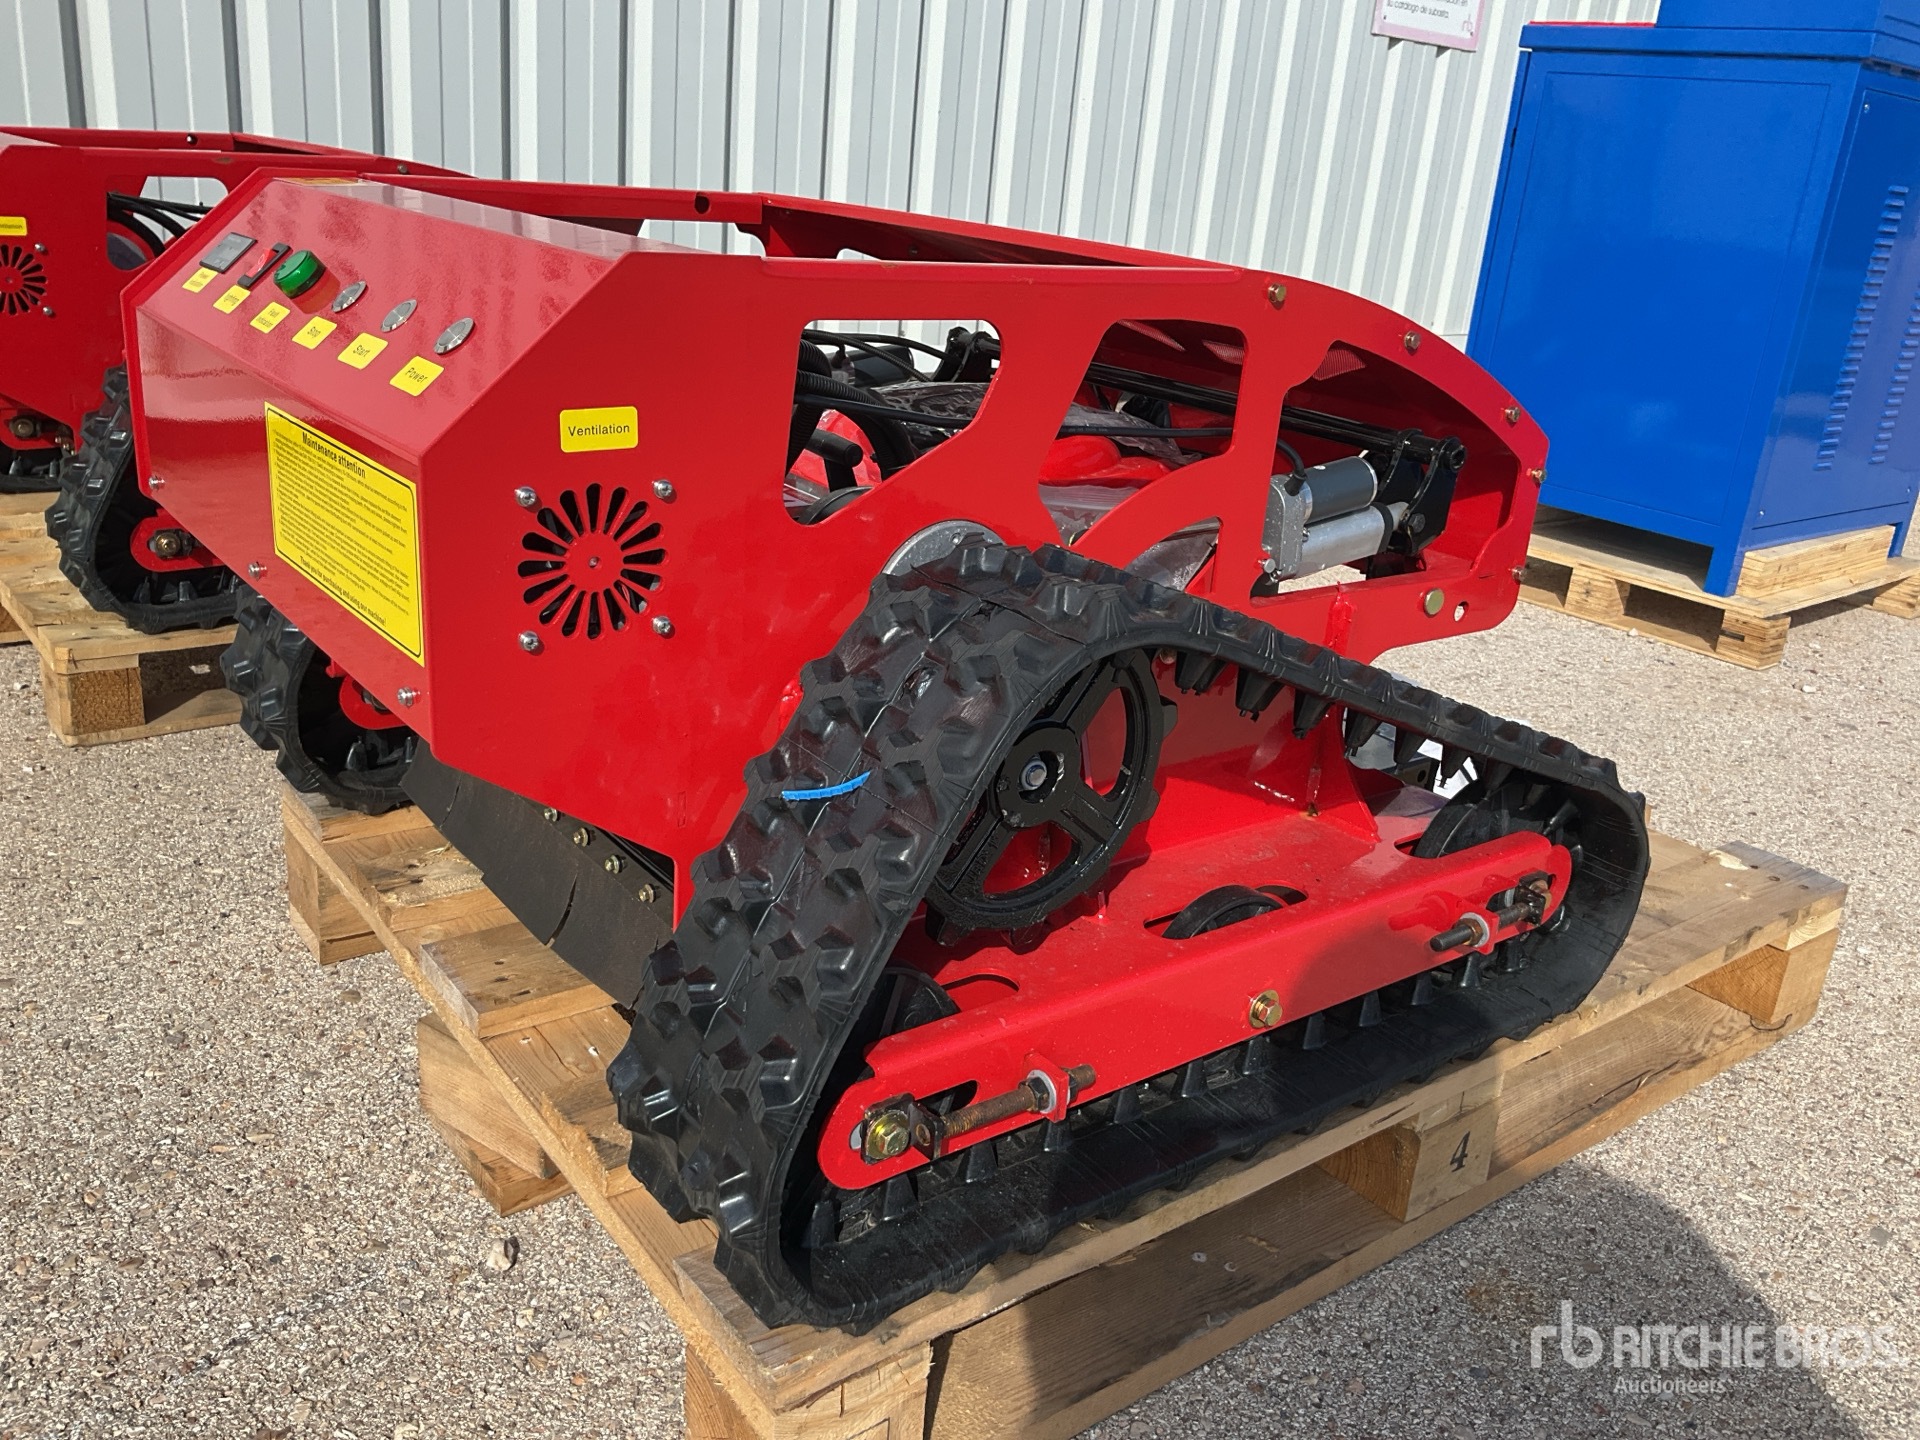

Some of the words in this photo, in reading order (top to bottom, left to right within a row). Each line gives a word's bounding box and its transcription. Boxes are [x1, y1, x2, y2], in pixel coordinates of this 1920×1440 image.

[307, 326, 321, 338] Stop
[353, 344, 371, 357] Start
[404, 367, 428, 383] Power
[567, 423, 631, 437] Ventilation
[302, 431, 338, 463] Maintenance
[338, 454, 366, 479] attention
[1449, 1131, 1471, 1173] 4
